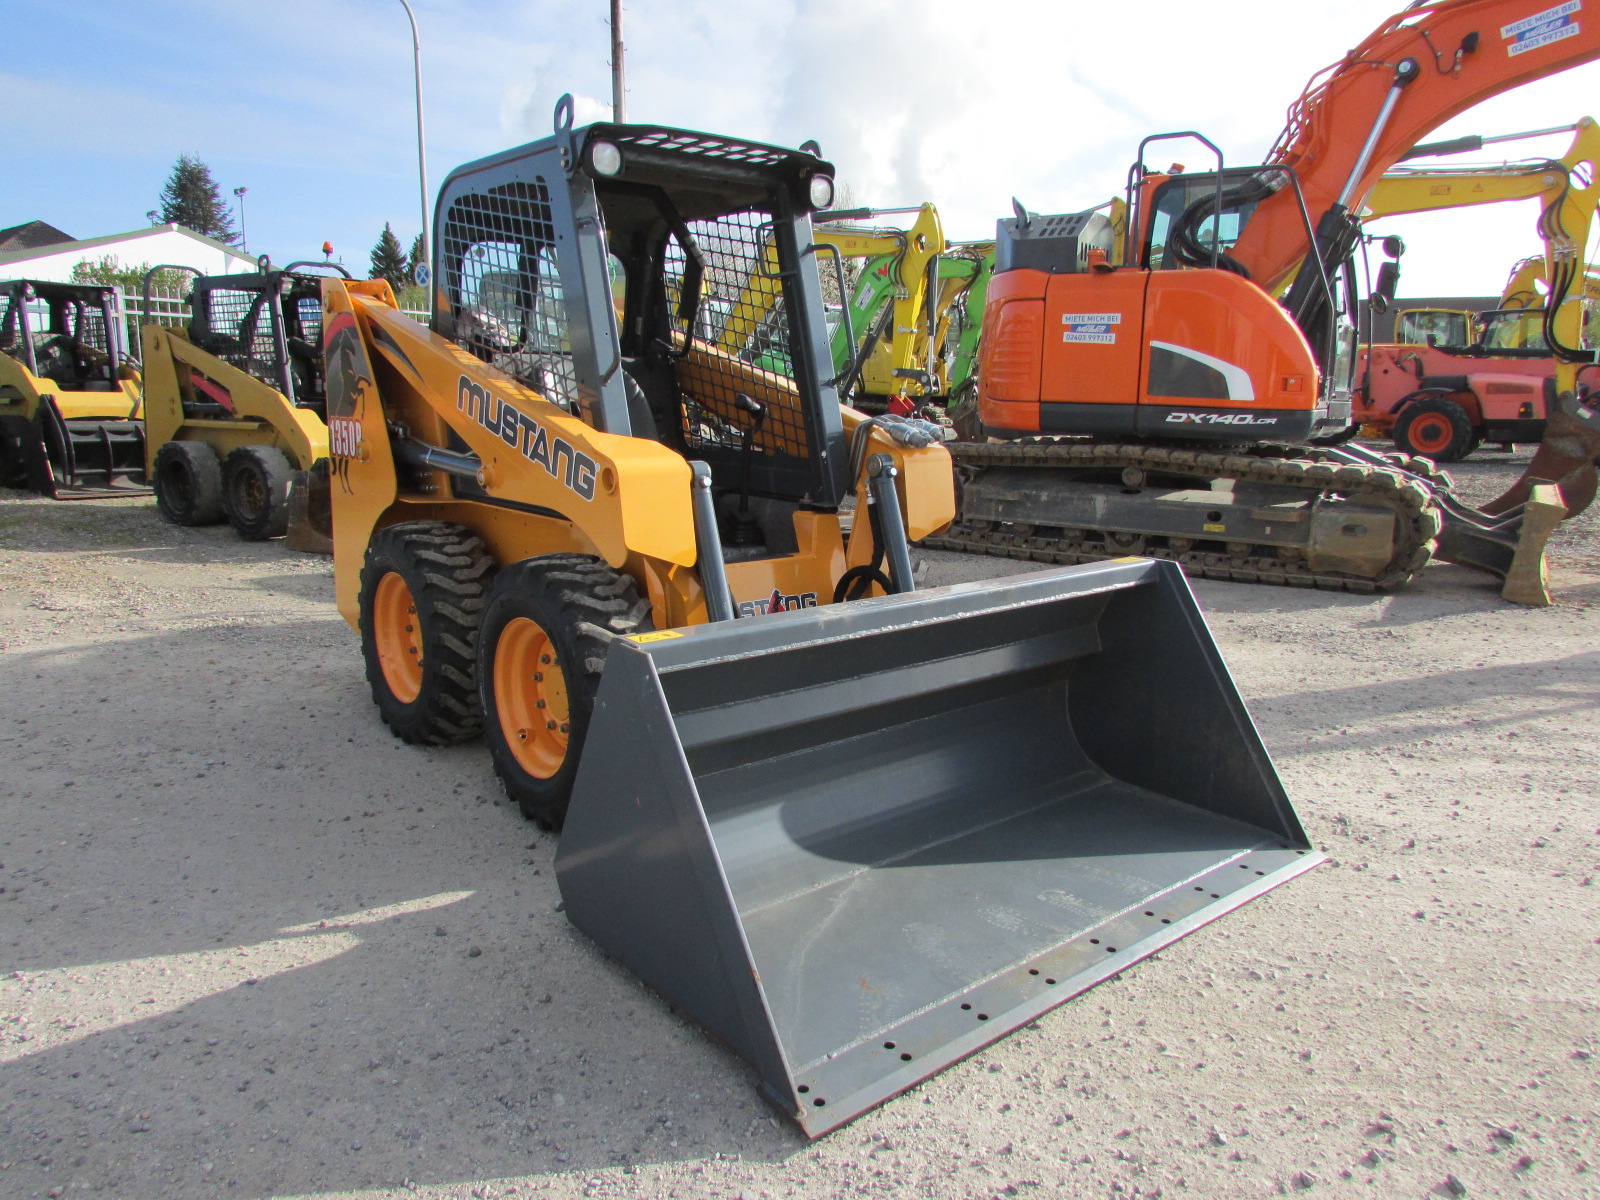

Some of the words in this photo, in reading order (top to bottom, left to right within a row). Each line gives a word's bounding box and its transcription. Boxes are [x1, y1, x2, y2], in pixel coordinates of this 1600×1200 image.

[1504, 18, 1533, 35] MIETE
[1534, 9, 1560, 24] MICH
[1561, 2, 1577, 13] BEI
[1511, 39, 1540, 54] 02403
[1065, 333, 1086, 341] 02403
[457, 374, 596, 502] MUSTANG
